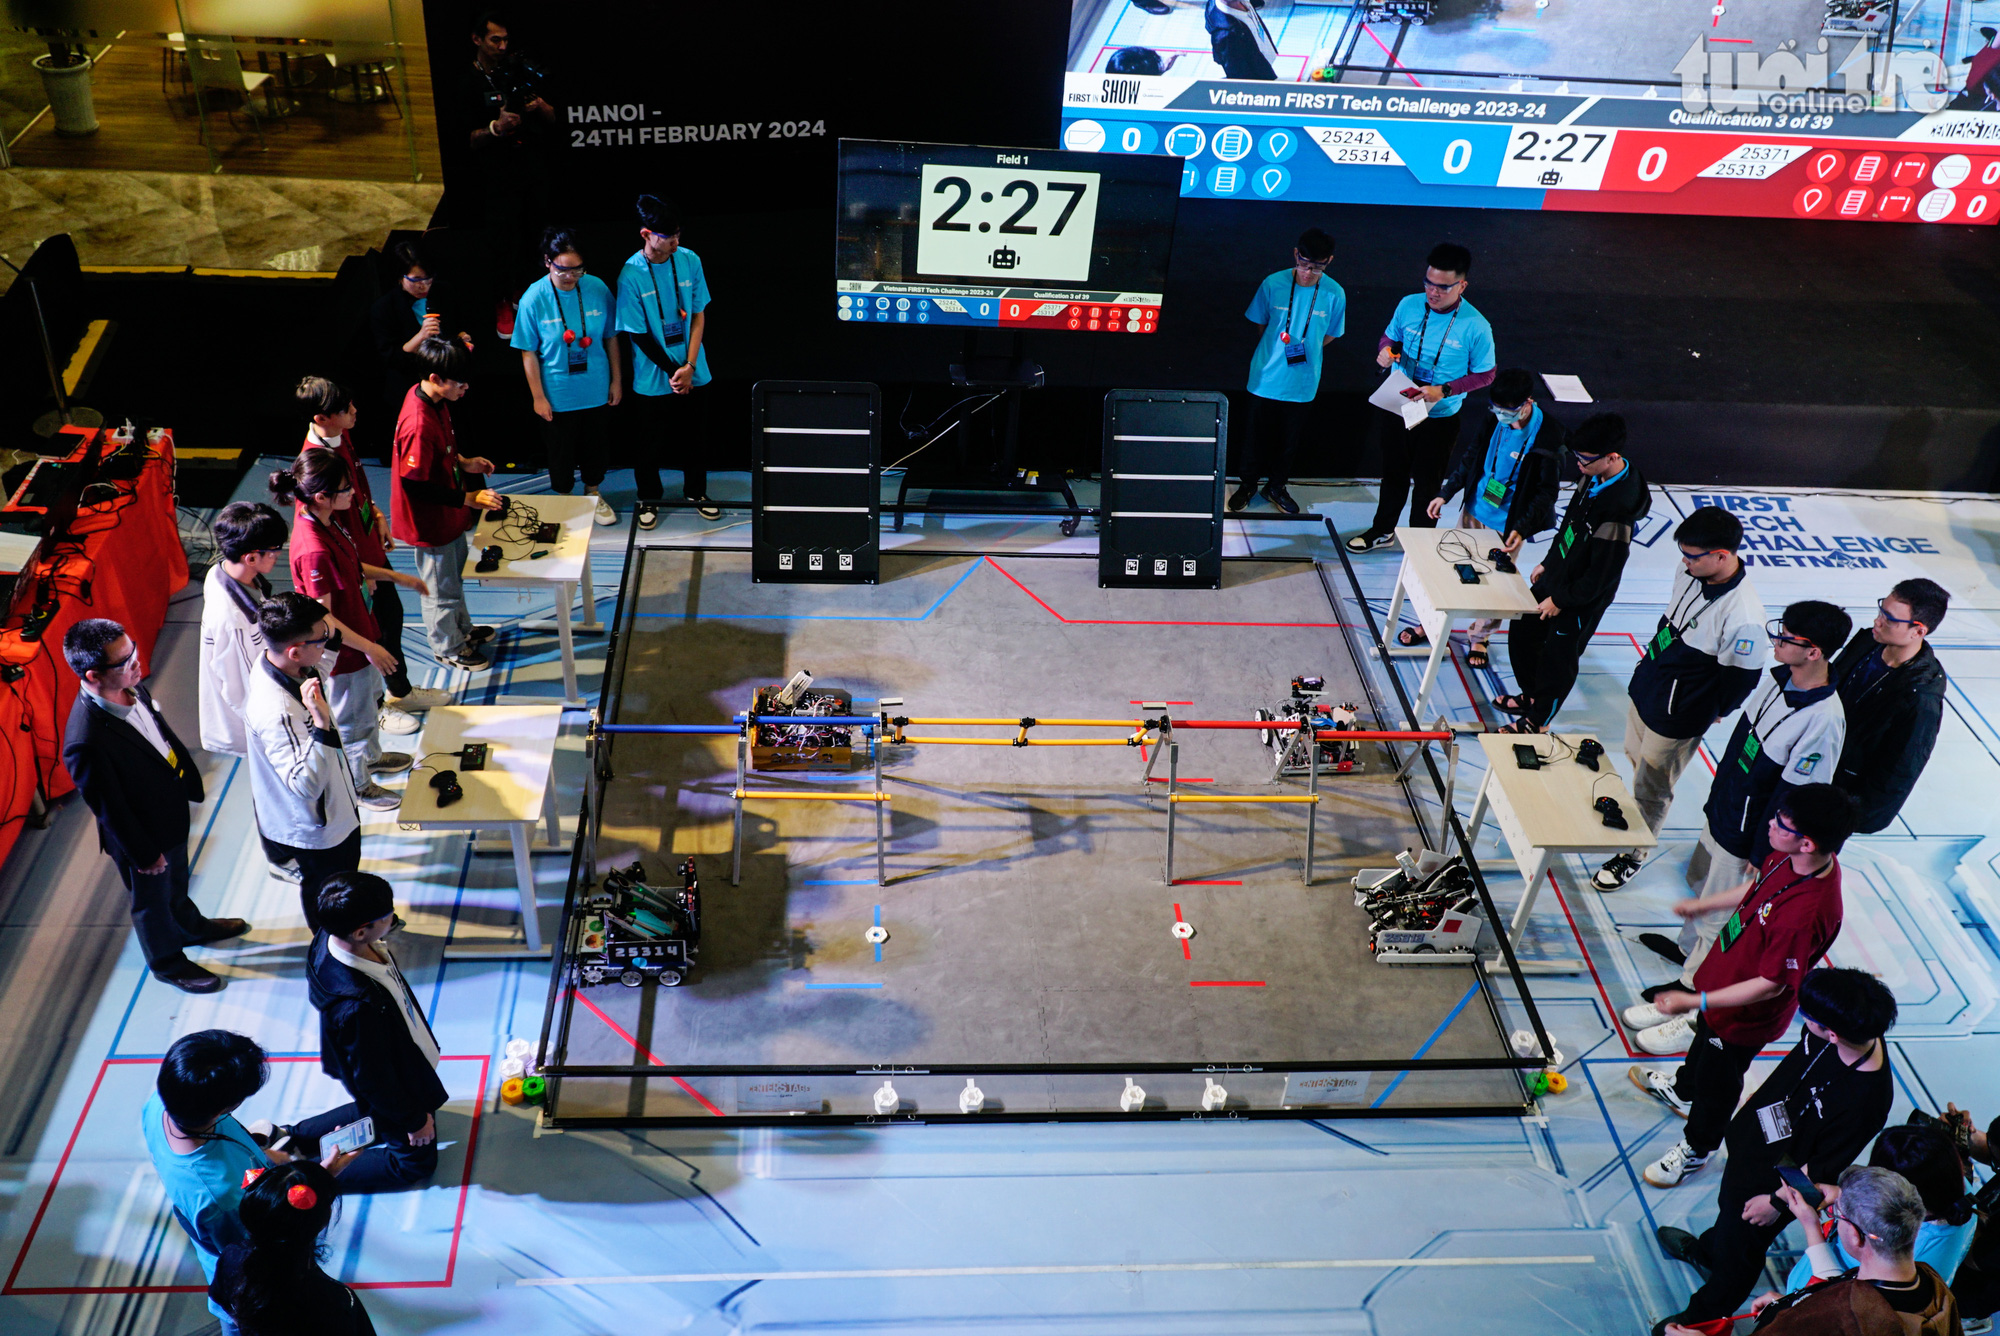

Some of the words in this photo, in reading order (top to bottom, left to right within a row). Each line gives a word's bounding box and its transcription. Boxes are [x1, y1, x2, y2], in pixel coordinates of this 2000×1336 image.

[1068, 93, 1091, 103] FIRST
[1101, 79, 1141, 105] SHOW
[1209, 89, 1280, 107] Vietnam
[1285, 93, 1337, 110] FIRST
[1341, 95, 1381, 112] Tech
[1386, 97, 1471, 118] Challenge
[1474, 101, 1547, 118] 2023-24
[567, 104, 645, 123] HANOI
[1668, 109, 1772, 128] Qualification
[1776, 115, 1788, 127] 3
[1790, 115, 1811, 129] of
[1812, 116, 1834, 130] 39
[571, 127, 633, 148] 24TH
[639, 122, 762, 145] FEBRUARY
[768, 120, 826, 139] 2024
[1121, 127, 1141, 152] 0
[1322, 130, 1375, 145] 25242
[1513, 131, 1607, 163] 2:27
[1739, 147, 1790, 161] 25371
[997, 154, 1021, 165] Field
[1023, 155, 1029, 165] 1
[1338, 149, 1390, 163] 25314
[1442, 138, 1472, 175] 0
[1637, 146, 1668, 182] 0
[1715, 163, 1767, 177] 25313
[1982, 161, 2000, 185] 0
[932, 176, 1088, 236] 2:27
[1967, 195, 1987, 218] 0
[882, 285, 907, 293] Vietnam
[941, 288, 969, 296] Challenge
[1034, 292, 1069, 300] Qualification
[856, 298, 863, 307] 0
[980, 303, 989, 316] 0
[1010, 304, 1020, 317] 0
[856, 310, 863, 319] 0
[1146, 311, 1153, 320] 0
[1144, 323, 1151, 331] 0
[1691, 495, 1792, 512] FIRST
[1737, 515, 1806, 532] ECH
[615, 946, 678, 958] 25314
